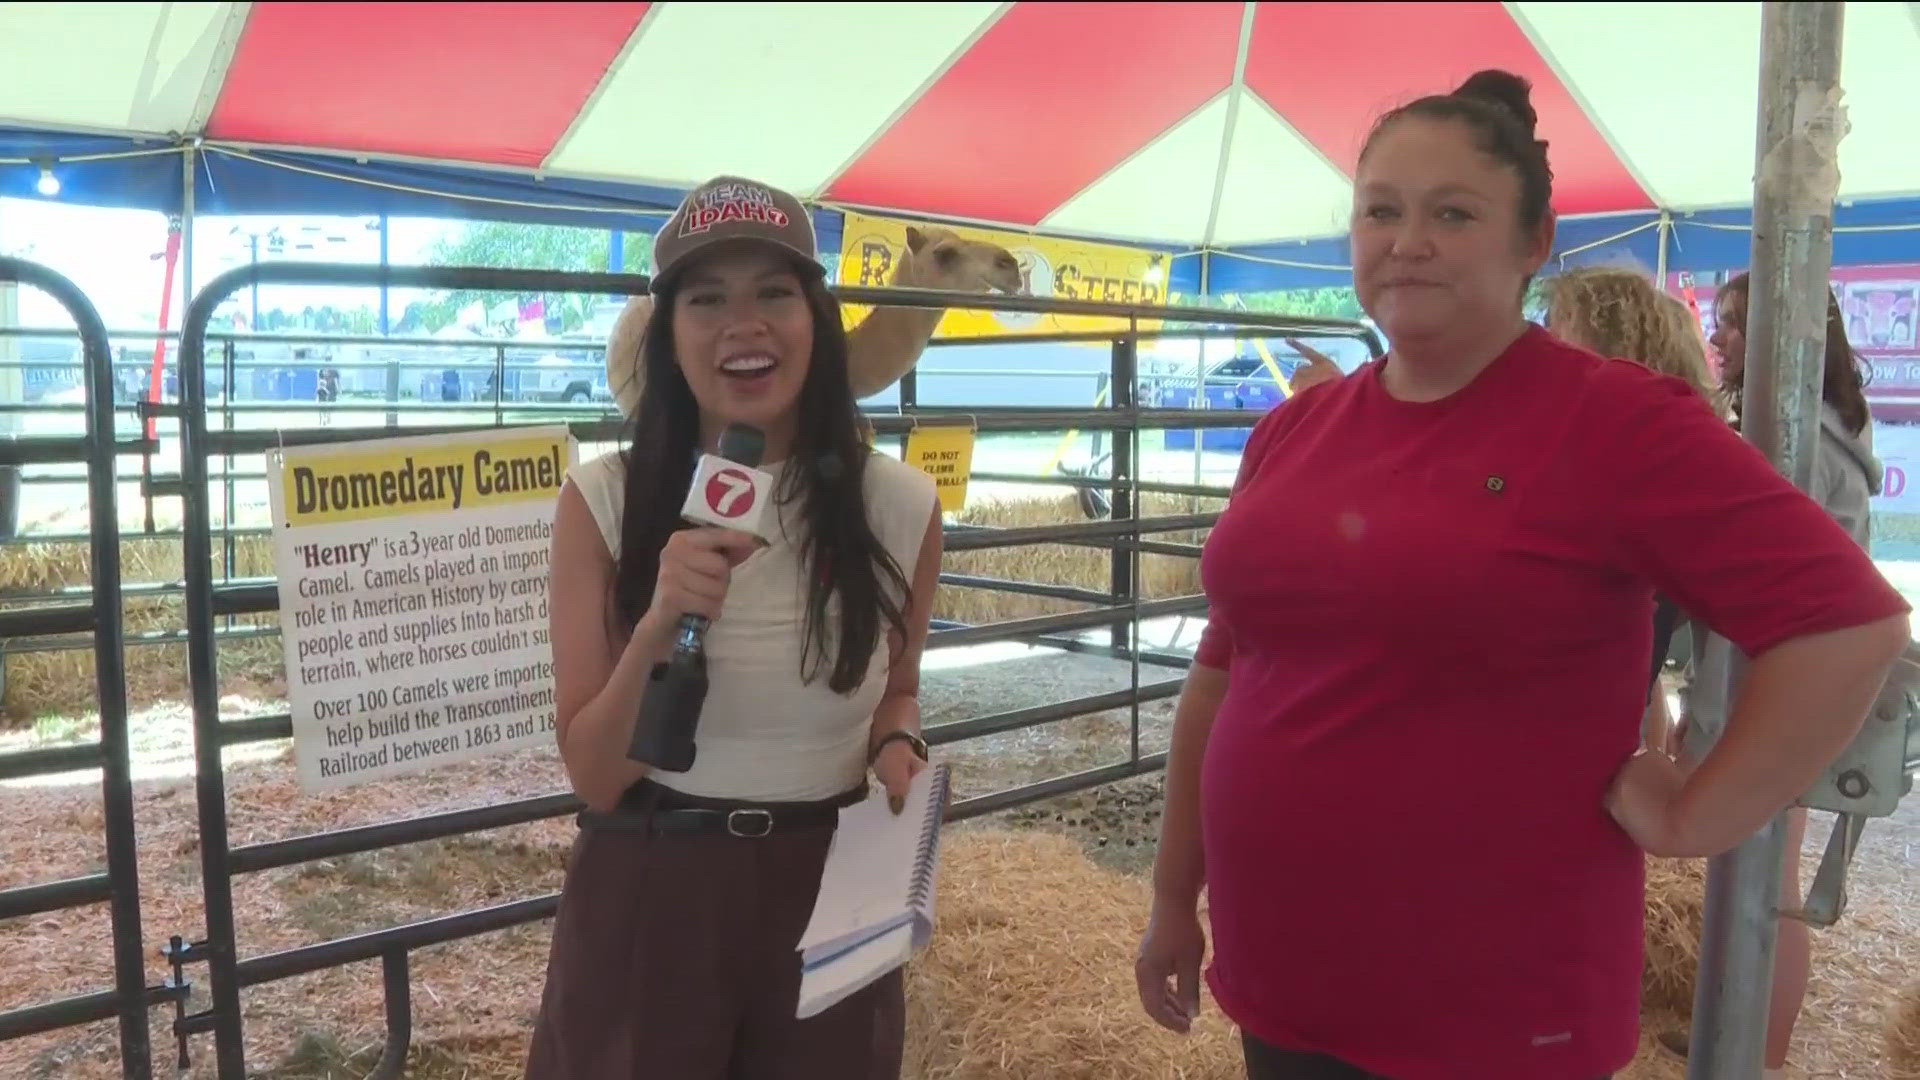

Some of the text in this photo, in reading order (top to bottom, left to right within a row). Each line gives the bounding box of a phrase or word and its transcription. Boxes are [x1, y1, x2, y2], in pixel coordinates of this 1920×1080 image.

[700, 183, 774, 206] TEAM
[922, 451, 960, 460] DO NOT
[294, 445, 562, 514] Dromedary Camel
[717, 472, 751, 514] 7
[294, 538, 378, 568] "Henry"
[384, 538, 397, 557] is
[399, 543, 408, 555] a
[409, 532, 420, 554] 3
[422, 533, 454, 560] year
[459, 527, 480, 546] old
[299, 574, 354, 598] Camel.
[364, 563, 420, 589] Camels
[425, 557, 474, 586] played
[480, 555, 498, 572] an
[295, 608, 325, 628] role
[332, 603, 347, 622] in
[353, 592, 426, 620] American
[432, 584, 484, 613] History
[490, 580, 507, 604] by
[299, 632, 353, 661] people
[358, 622, 388, 646] and
[394, 612, 457, 643] supplies
[461, 607, 490, 630] into
[495, 602, 534, 626] harsh
[301, 630, 553, 685] terrain, where horses couldn't su
[313, 699, 351, 720] Over
[357, 690, 388, 712] 100
[392, 681, 449, 707] Camels
[453, 673, 490, 694] were
[320, 748, 388, 777] Railroad
[393, 734, 460, 763] between
[465, 726, 501, 749] 1863
[506, 717, 533, 738] and
[326, 723, 363, 748] help
[369, 713, 411, 738] build
[416, 708, 441, 728] the
